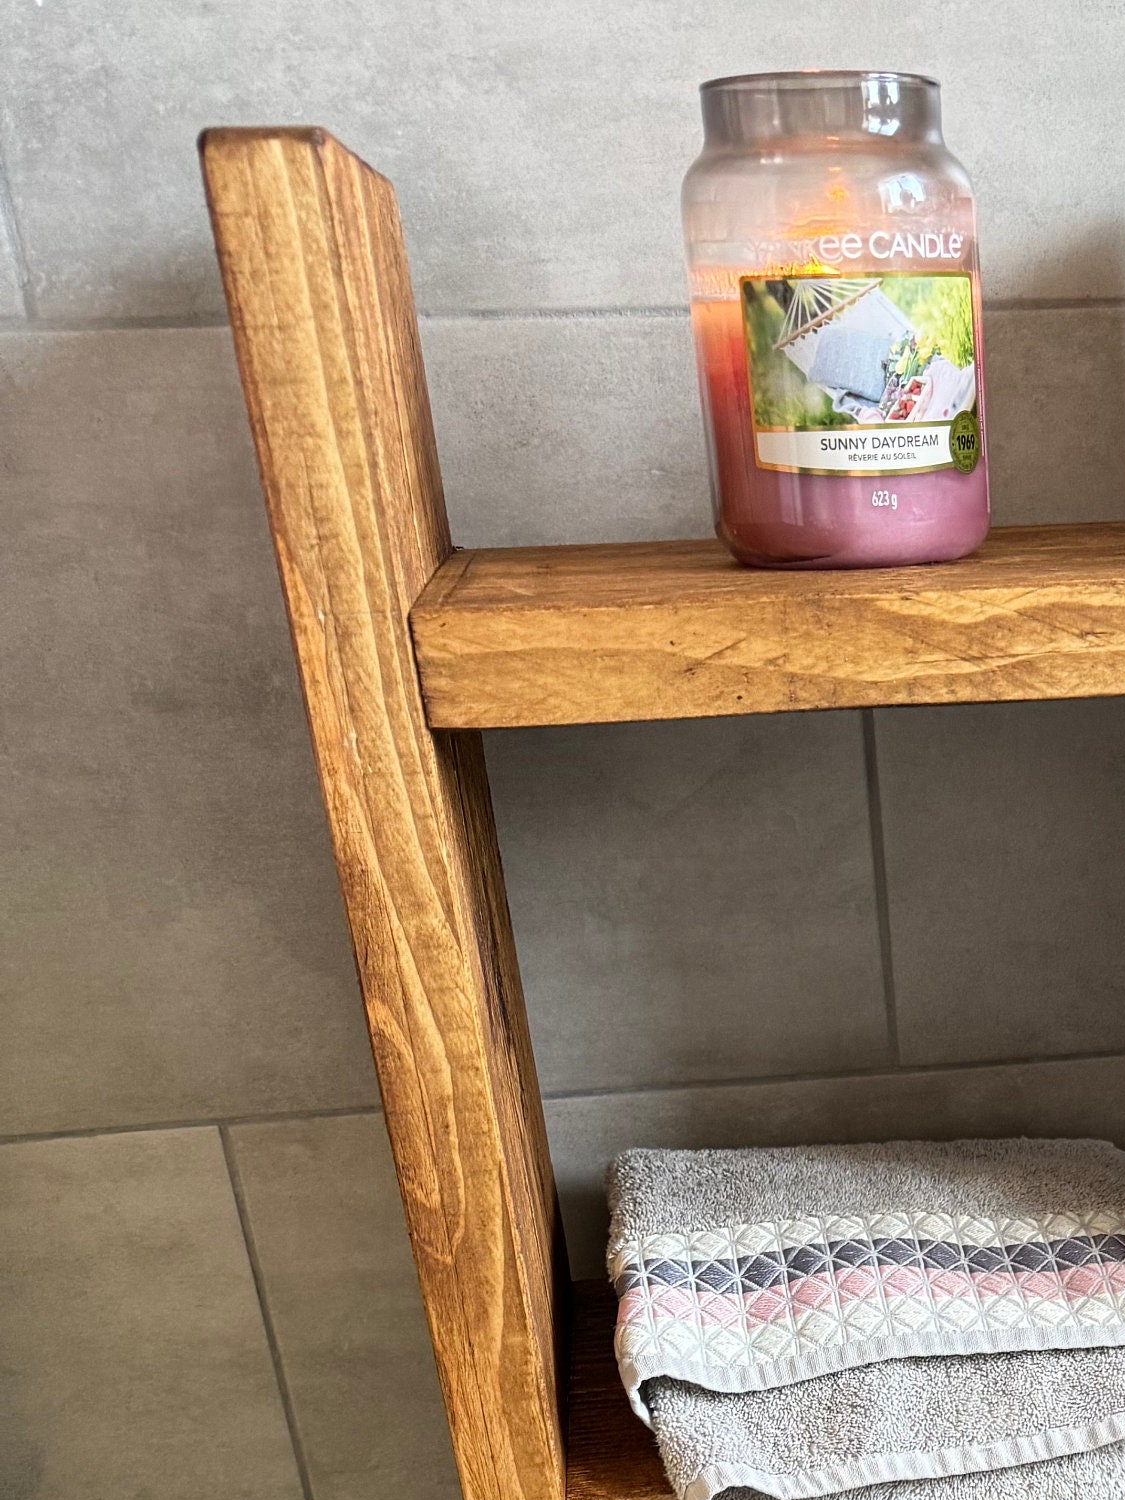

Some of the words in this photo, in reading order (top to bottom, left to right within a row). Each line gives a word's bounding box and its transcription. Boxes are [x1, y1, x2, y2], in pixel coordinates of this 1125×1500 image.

[820, 437, 868, 452] SUNNY
[871, 434, 939, 449] DAYDREAM
[956, 434, 975, 451] 1969
[880, 453, 892, 461] AU
[872, 490, 889, 507] 623
